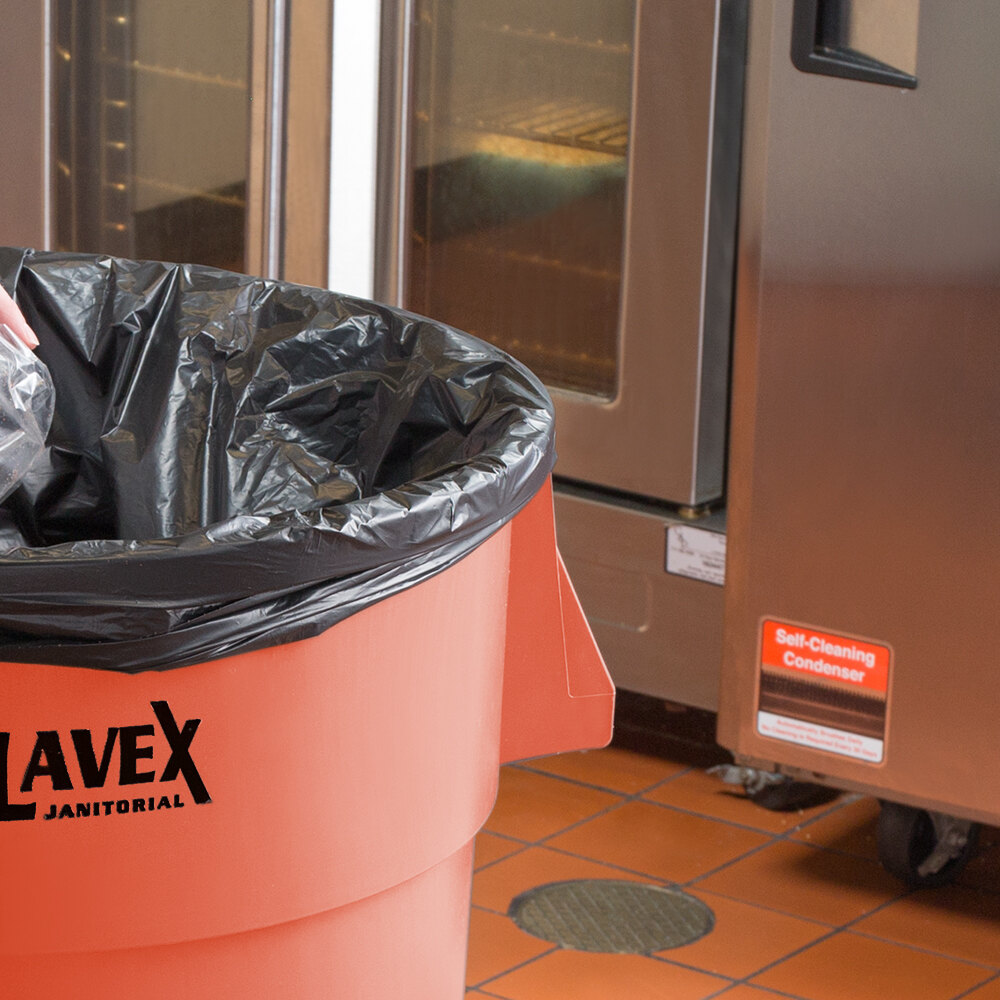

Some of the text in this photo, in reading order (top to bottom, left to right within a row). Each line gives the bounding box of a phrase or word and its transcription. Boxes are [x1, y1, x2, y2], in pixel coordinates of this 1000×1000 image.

[776, 628, 875, 669] Self-Cleaning
[783, 651, 866, 682] Condenser
[43, 794, 185, 820] JANITORIAL
